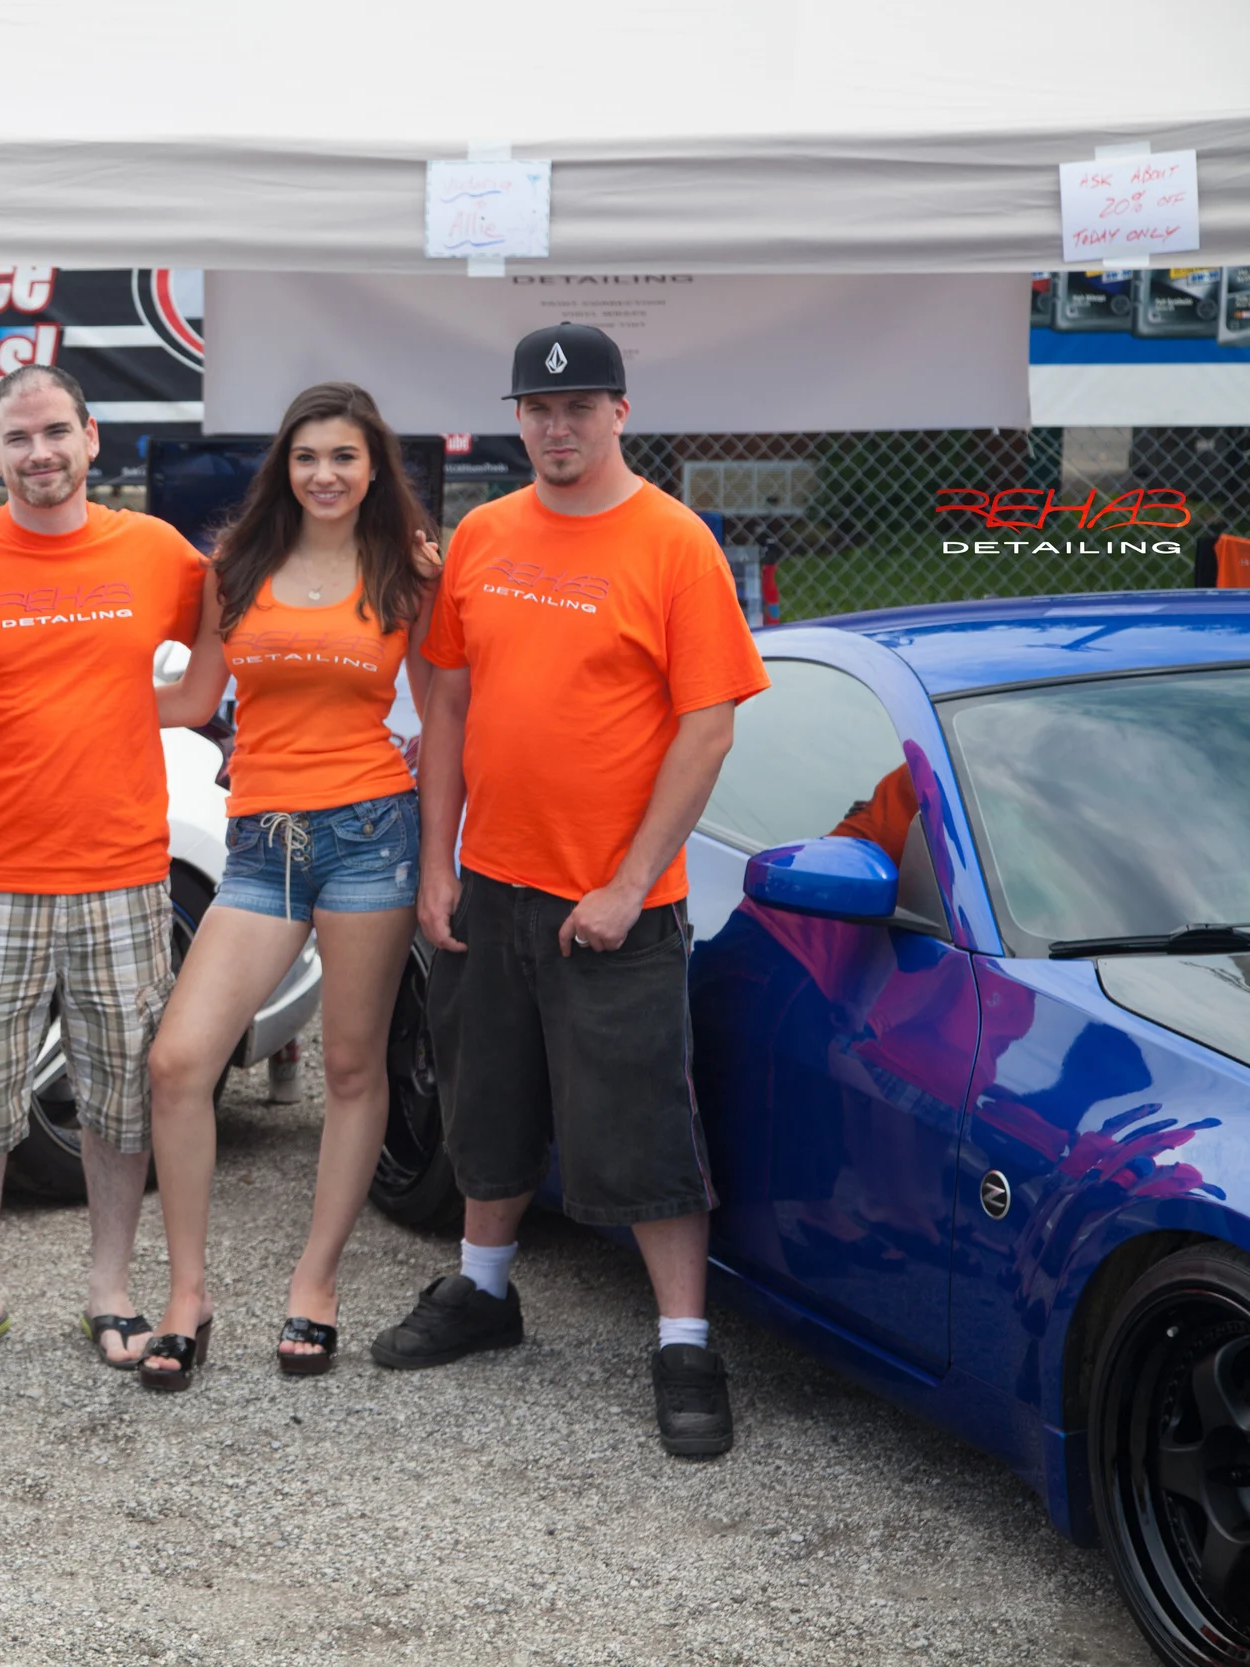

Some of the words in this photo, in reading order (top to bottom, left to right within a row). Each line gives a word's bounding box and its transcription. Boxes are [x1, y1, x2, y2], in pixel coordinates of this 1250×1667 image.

[1079, 173, 1113, 189] ASK
[1130, 164, 1180, 184] ABOUT
[1126, 226, 1181, 244] ONLY
[512, 274, 695, 286] DETAILING
[487, 558, 610, 599] REHAB
[483, 583, 597, 614] DETAILING
[1, 608, 134, 629] DETAILING
[232, 653, 378, 673] DETAILING
